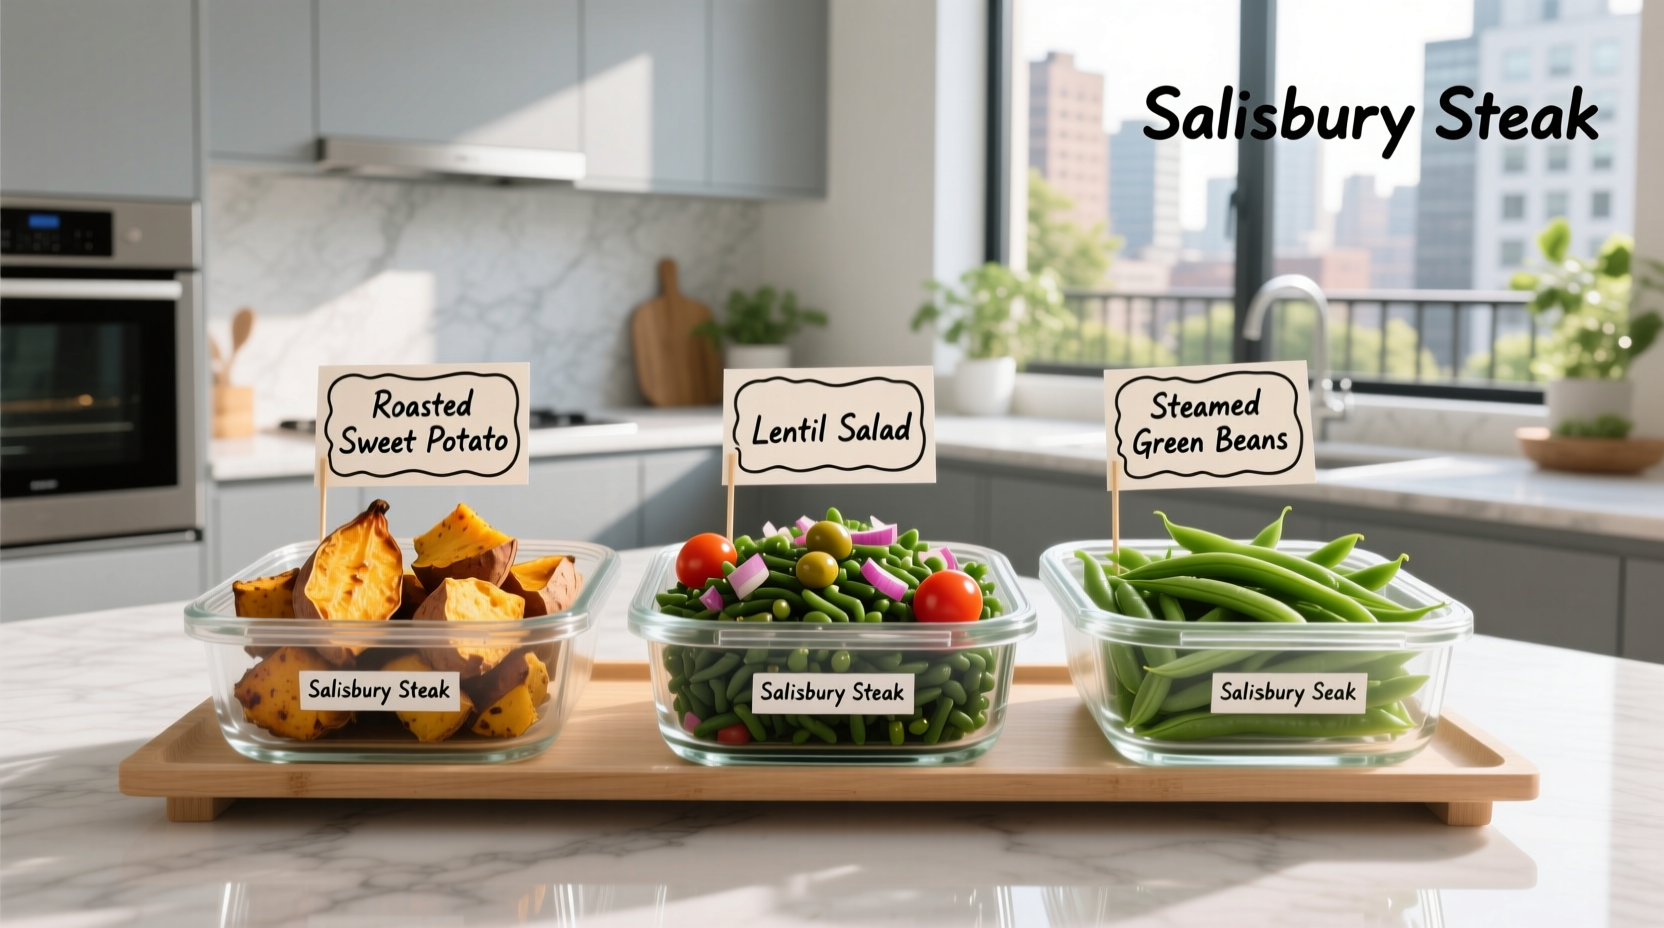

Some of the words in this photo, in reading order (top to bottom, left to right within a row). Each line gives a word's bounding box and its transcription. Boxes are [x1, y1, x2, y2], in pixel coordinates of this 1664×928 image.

[372, 387, 474, 419] Roasted
[1150, 388, 1262, 420] Steamed
[338, 425, 417, 455] Sweet
[426, 424, 509, 454] Potato
[752, 413, 827, 445] Lentil
[837, 411, 913, 443] Salad
[1132, 427, 1204, 460] Green
[1215, 425, 1288, 453] Beans
[308, 678, 392, 706] Salisbury
[398, 678, 451, 699] Steak
[760, 681, 846, 708] Salisbury
[852, 681, 905, 701] Steak
[1220, 681, 1305, 708] Salisbury
[1311, 681, 1356, 701] Seak
